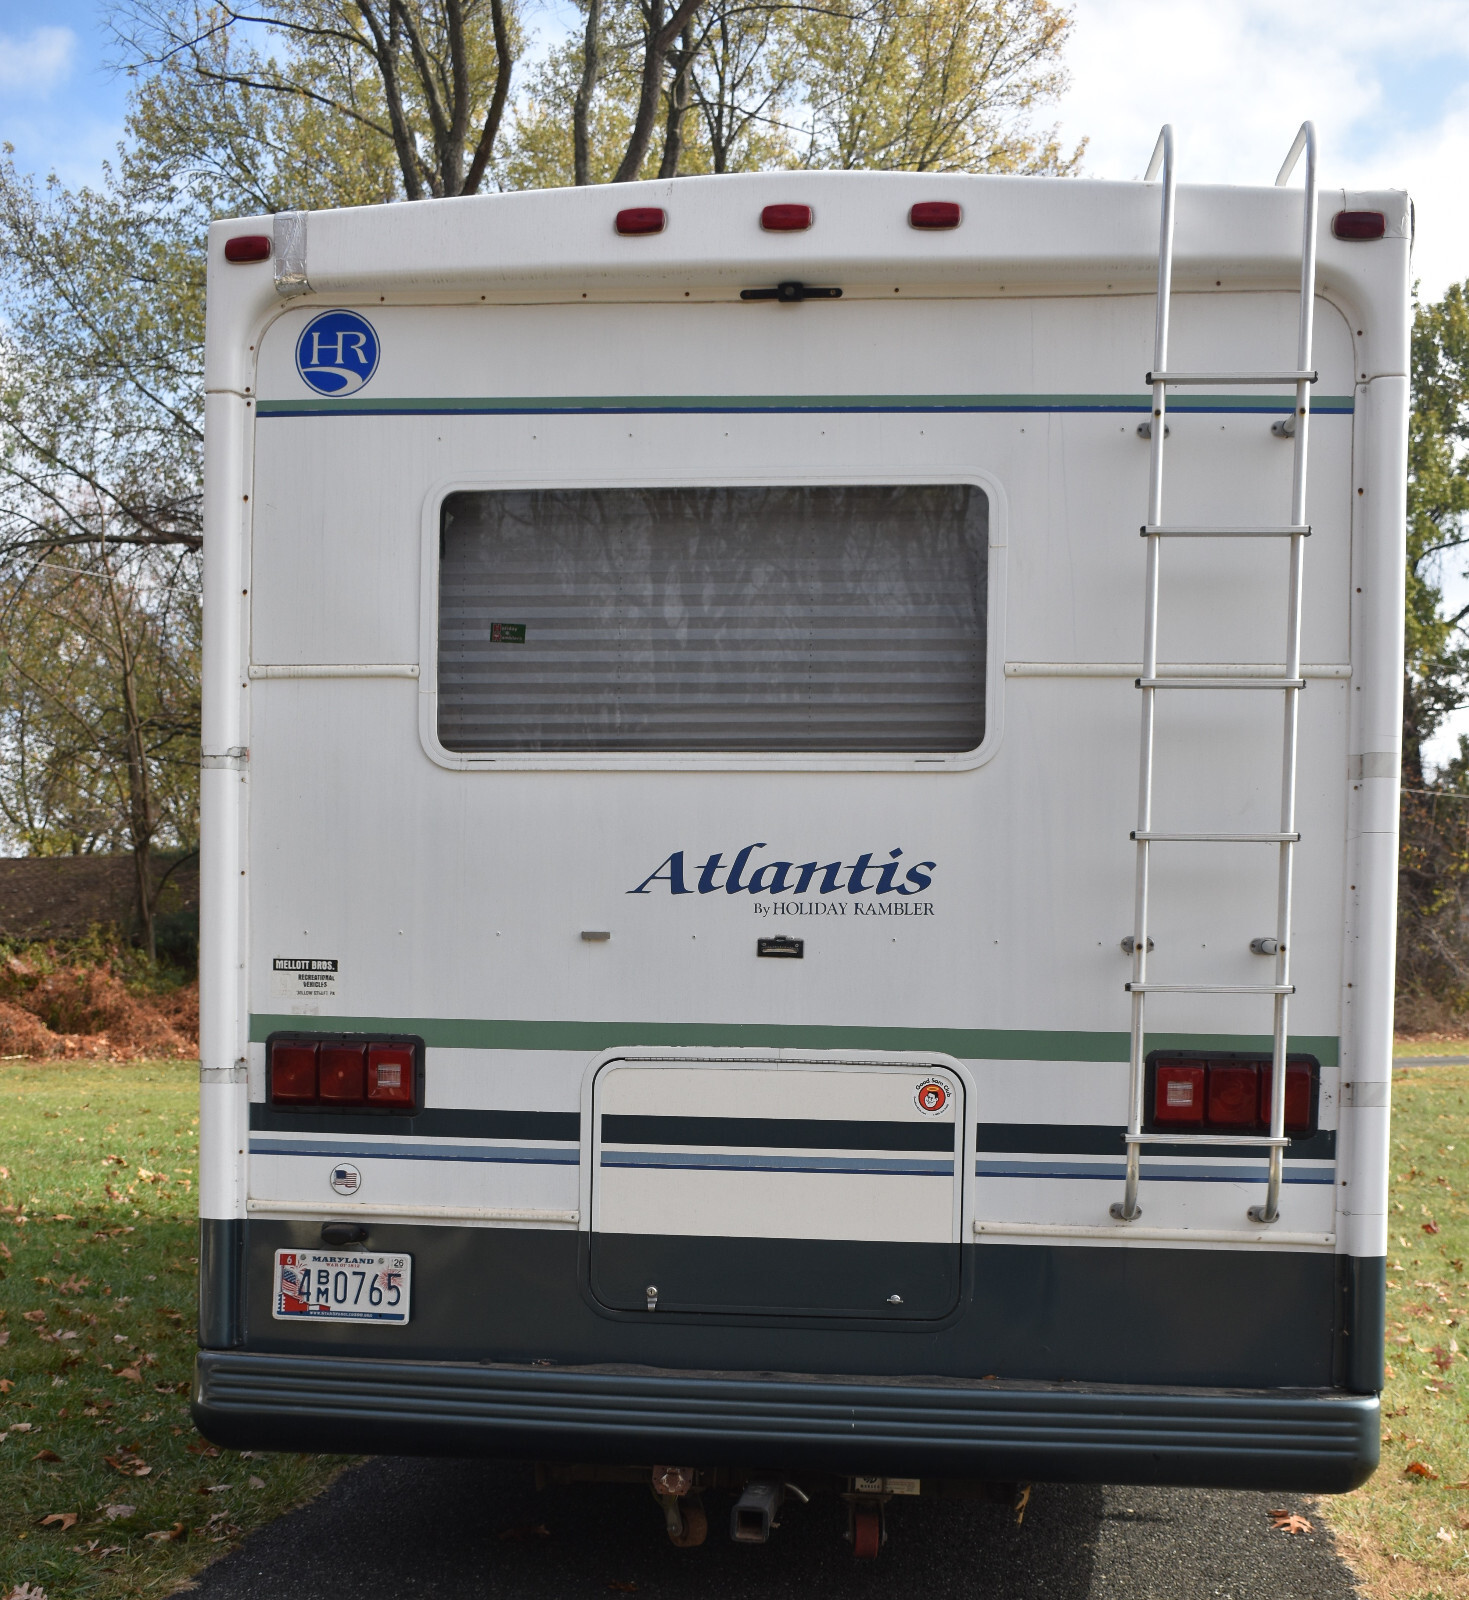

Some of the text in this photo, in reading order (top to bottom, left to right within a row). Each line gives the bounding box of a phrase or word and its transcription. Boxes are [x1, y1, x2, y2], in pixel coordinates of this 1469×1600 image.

[310, 331, 368, 364] HR
[625, 842, 937, 895] Atlantis
[754, 902, 935, 917] By HOLIDAY RAMBLER
[275, 960, 335, 971] MELLOTT BROS.
[915, 1077, 952, 1098] Good Sam Club
[286, 1256, 292, 1264] 6
[312, 1256, 375, 1264] MARYLAND
[393, 1258, 404, 1268] 26
